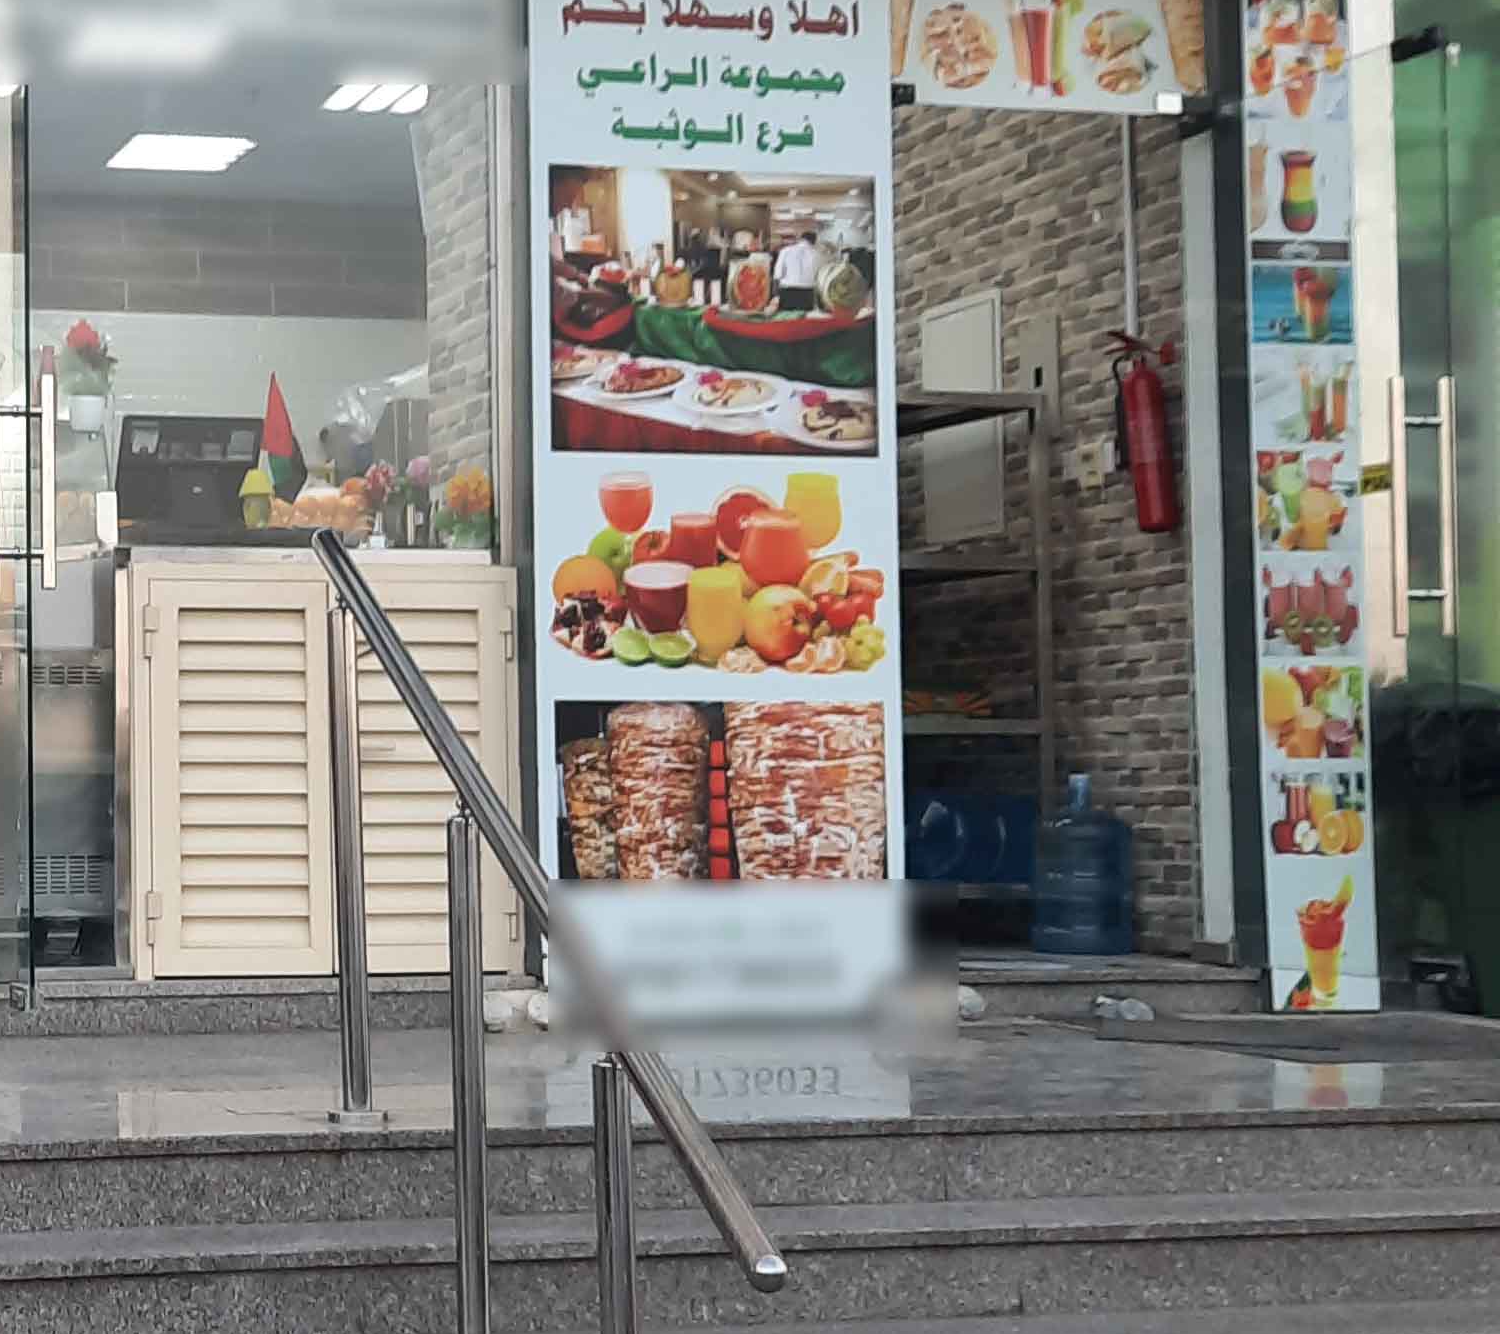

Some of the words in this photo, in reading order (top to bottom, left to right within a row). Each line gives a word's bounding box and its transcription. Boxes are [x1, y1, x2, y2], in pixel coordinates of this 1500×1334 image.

[577, 52, 708, 98] الراعي
[719, 53, 846, 100] مجموعة
[611, 107, 744, 150] الوثبة
[755, 114, 815, 154] فرع
